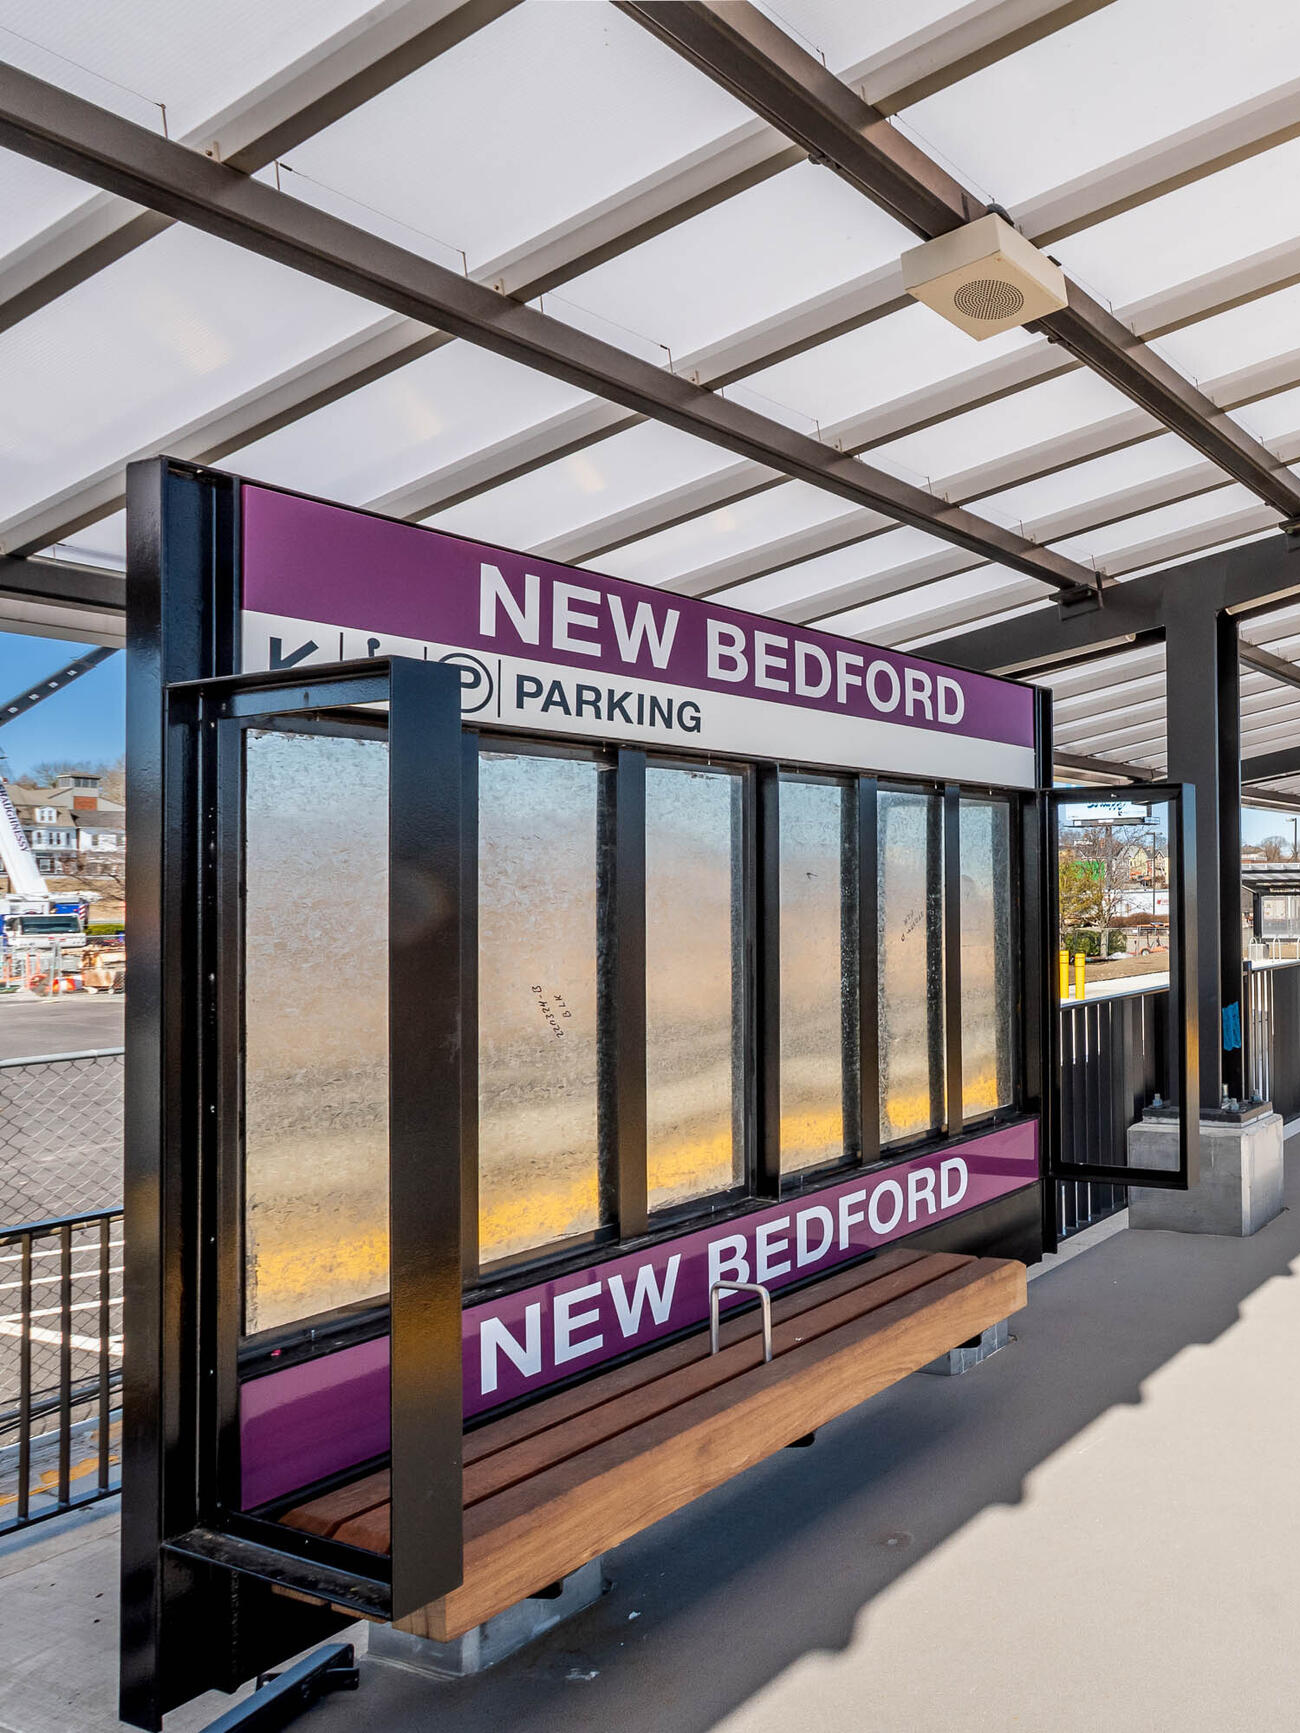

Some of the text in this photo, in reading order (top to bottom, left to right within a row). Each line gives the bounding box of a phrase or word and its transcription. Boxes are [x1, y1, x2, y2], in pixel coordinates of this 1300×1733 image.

[480, 562, 966, 725] NEW BEDFORD
[515, 673, 702, 734] PARKING
[481, 1157, 968, 1395] NEW BEDFORD
